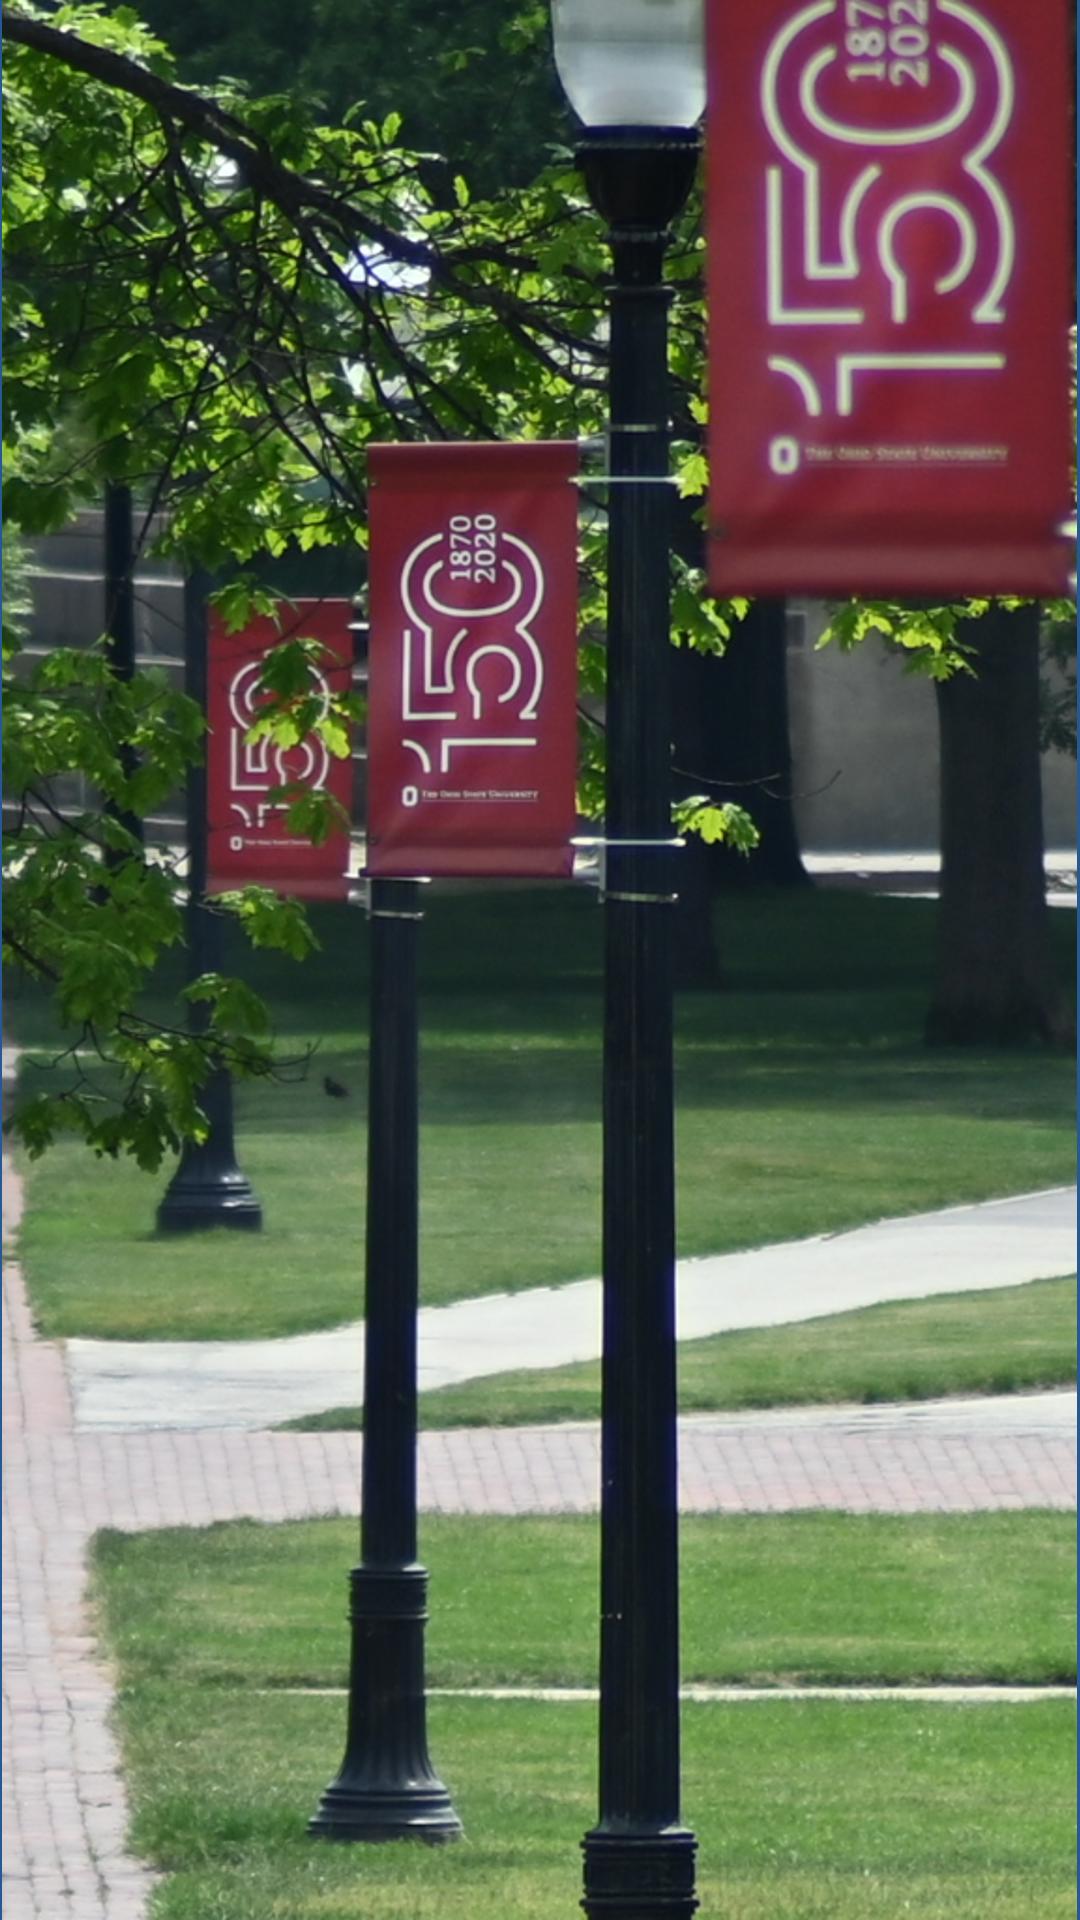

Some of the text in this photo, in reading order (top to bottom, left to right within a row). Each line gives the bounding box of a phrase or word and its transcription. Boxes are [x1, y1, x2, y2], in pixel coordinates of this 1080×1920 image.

[845, 0, 886, 82] 187
[888, 0, 930, 88] 202
[449, 515, 472, 581] 1870
[474, 514, 496, 584] 2020
[401, 533, 544, 774] 150
